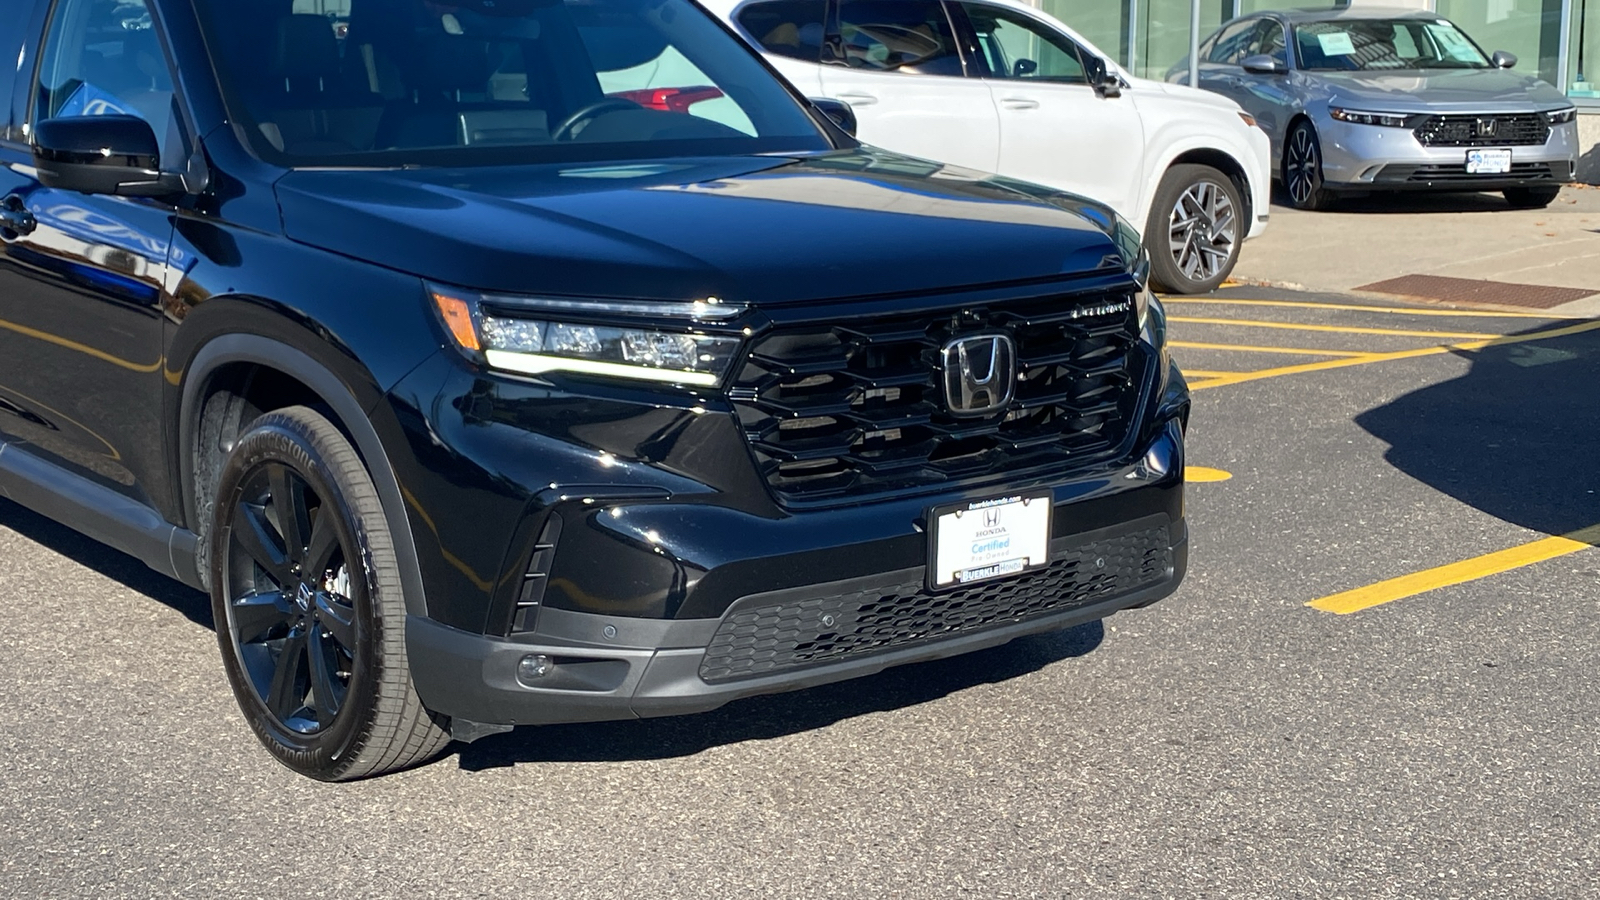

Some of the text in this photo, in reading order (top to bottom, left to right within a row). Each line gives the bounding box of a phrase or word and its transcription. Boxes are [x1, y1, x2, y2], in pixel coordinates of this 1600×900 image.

[976, 527, 1006, 537] HONDA
[971, 537, 1010, 554] Certified
[962, 562, 1021, 581] BUERKLE HONDA
